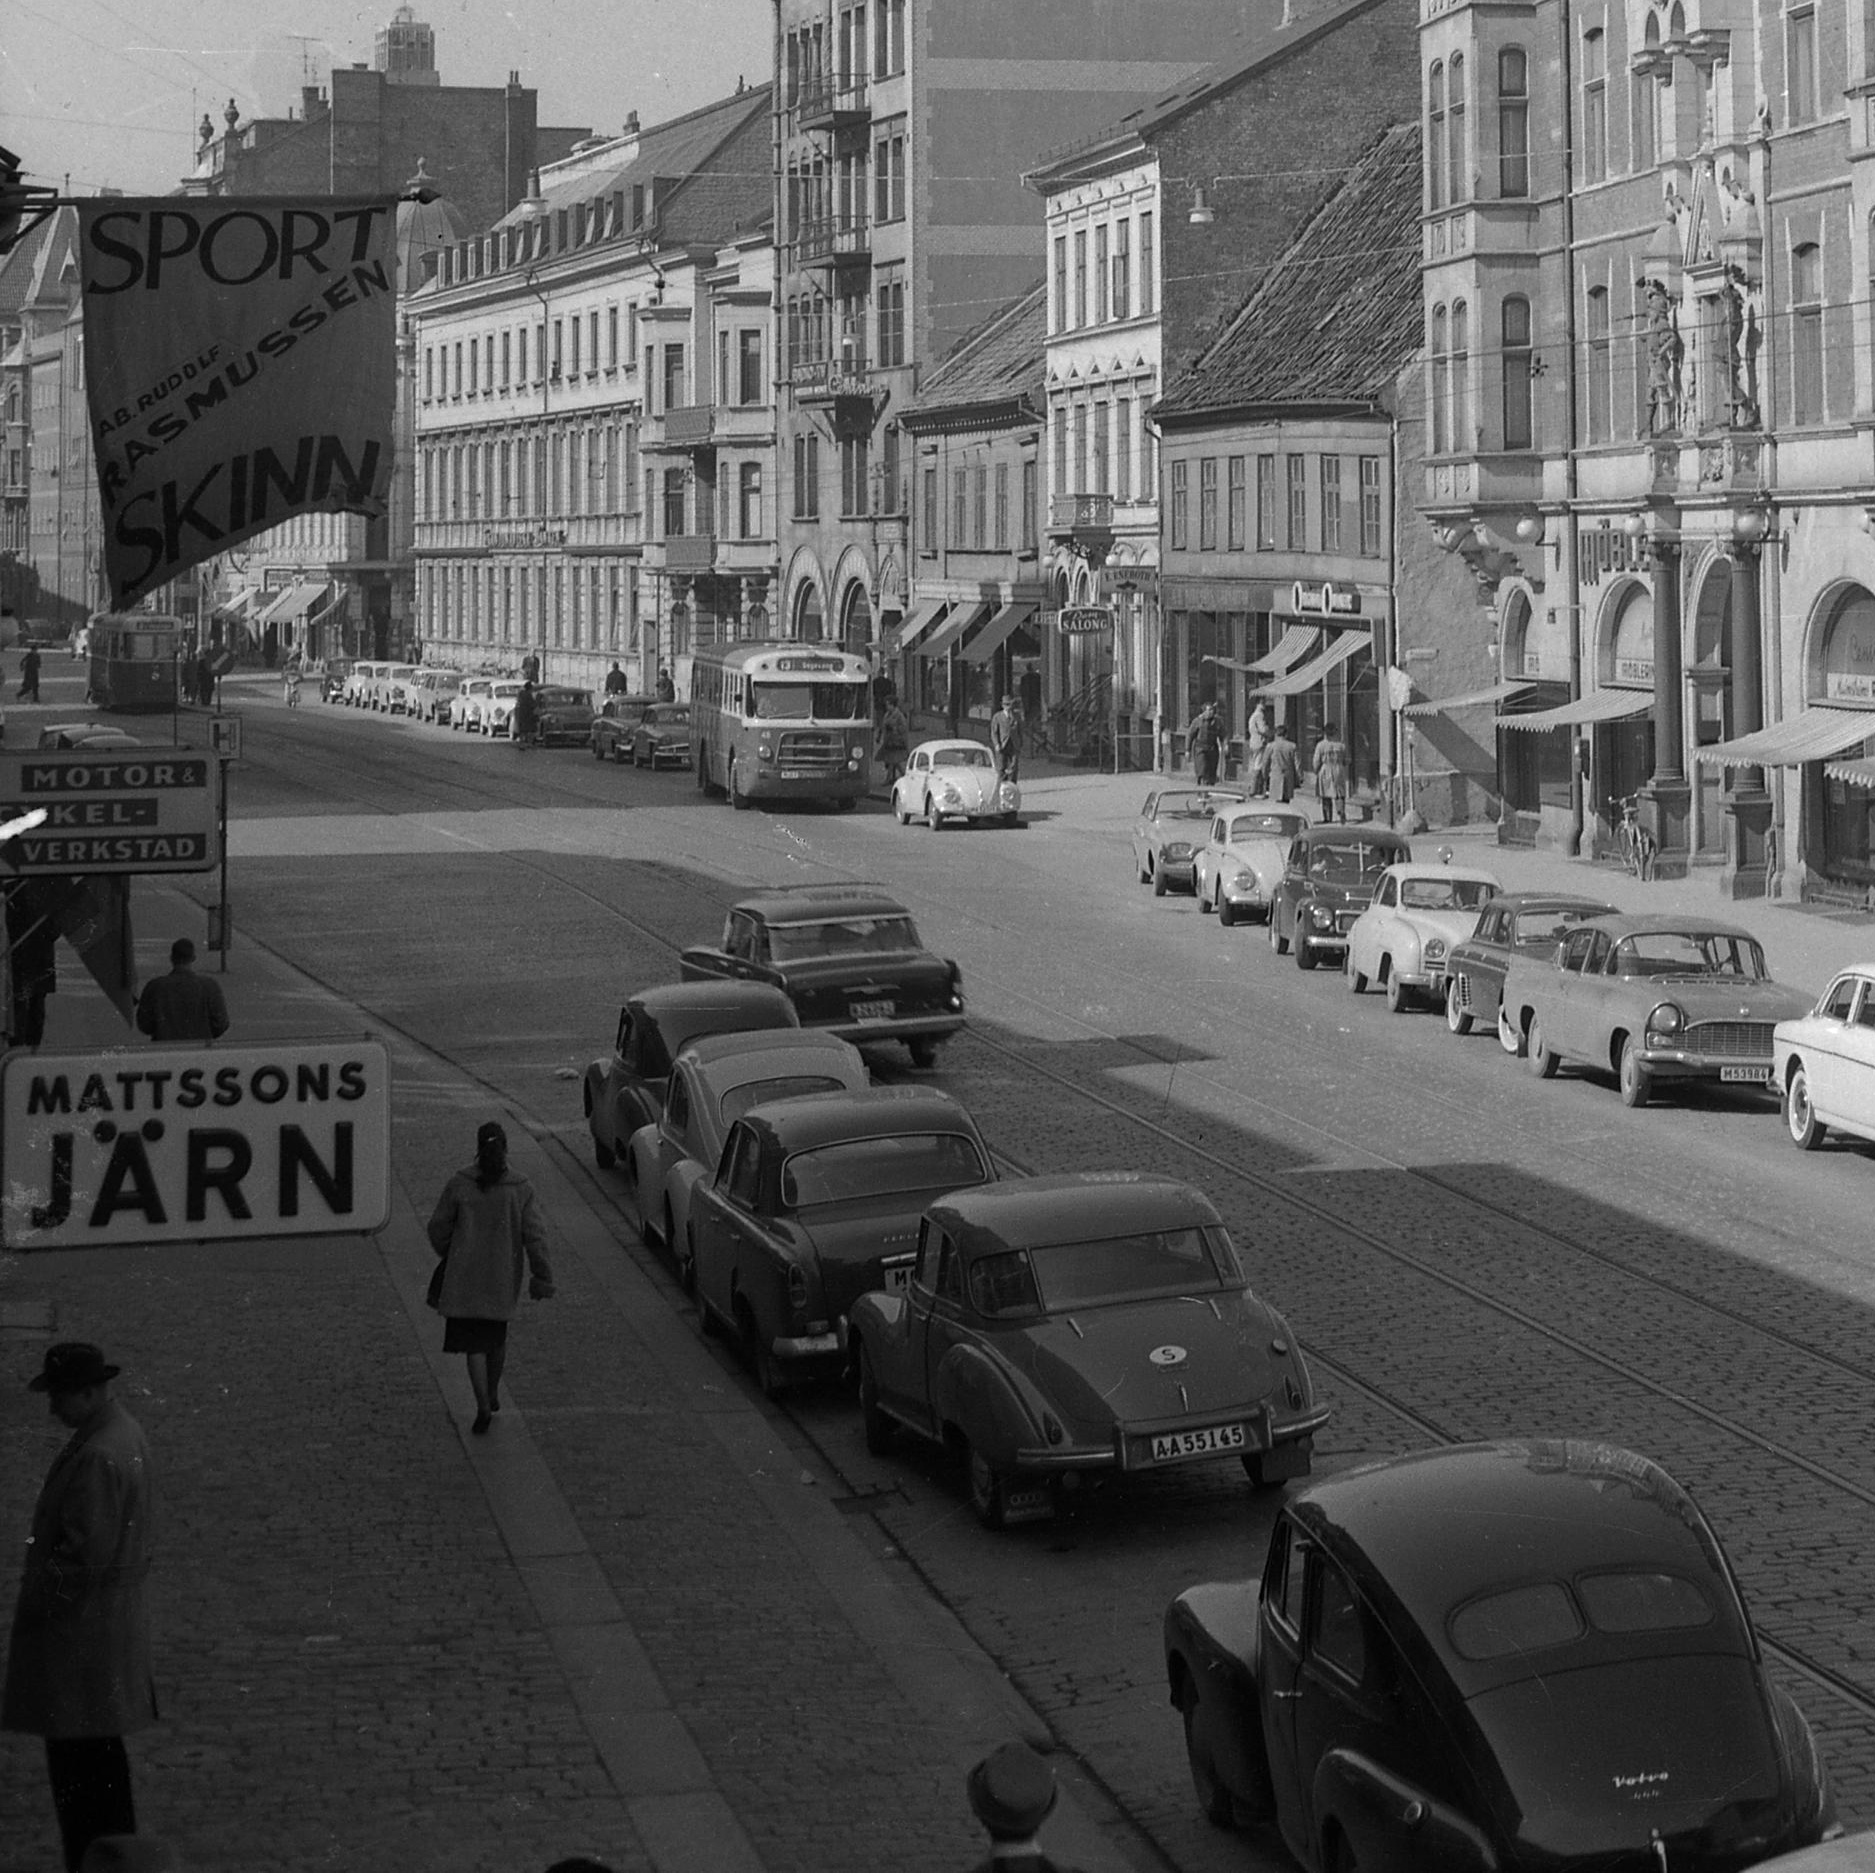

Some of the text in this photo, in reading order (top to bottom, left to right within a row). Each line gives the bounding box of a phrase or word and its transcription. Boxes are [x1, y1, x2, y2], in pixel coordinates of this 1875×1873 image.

[88, 207, 388, 295] SPORT
[103, 259, 390, 509] RASMUSSEN
[116, 435, 381, 596] SKINN
[1062, 618, 1108, 631] SALONG
[33, 764, 196, 789] MOTOR &
[22, 837, 195, 863] VERKSTAD
[27, 1061, 367, 1115] MATTSSONS
[31, 1118, 354, 1229] JÄRN
[1161, 1349, 1176, 1362] S
[1612, 1771, 1669, 1788] Volvo
